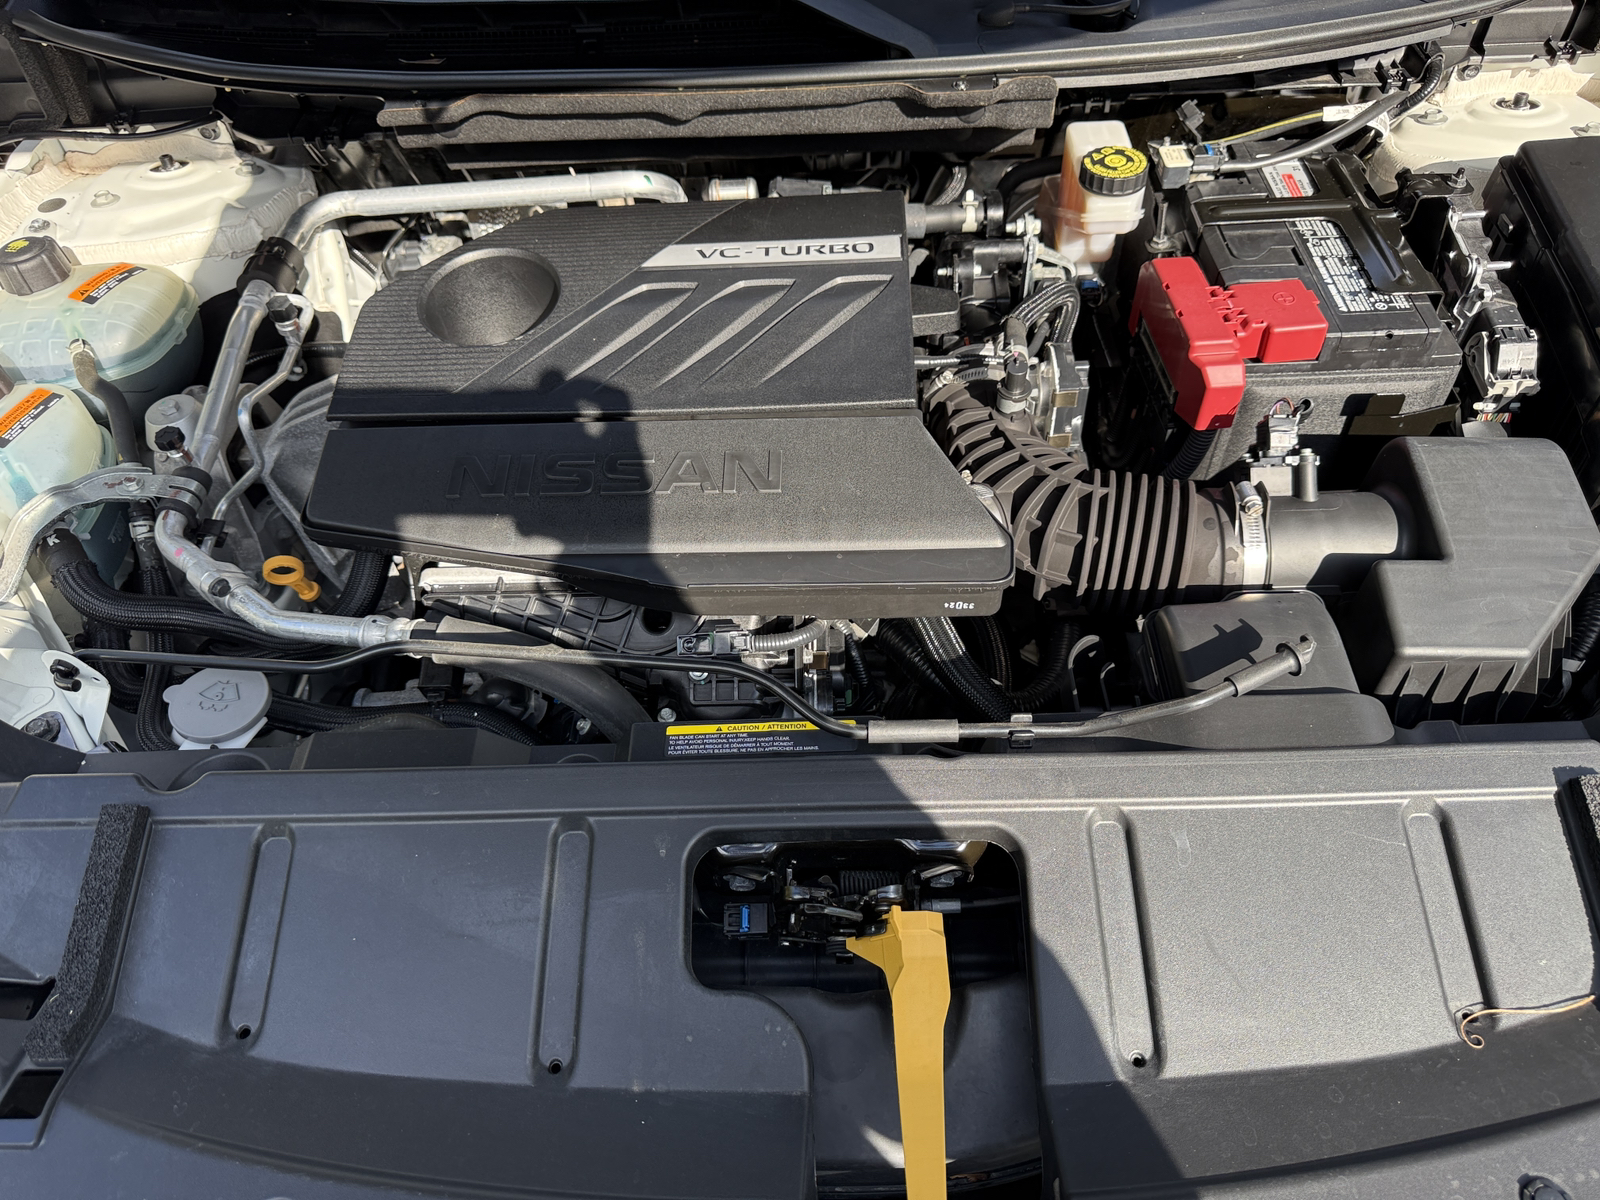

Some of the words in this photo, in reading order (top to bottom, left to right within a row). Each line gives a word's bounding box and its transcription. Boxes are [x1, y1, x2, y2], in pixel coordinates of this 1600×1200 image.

[696, 242, 875, 259] VC-TURBO
[445, 449, 783, 498] NISSAN
[46, 534, 61, 546] K
